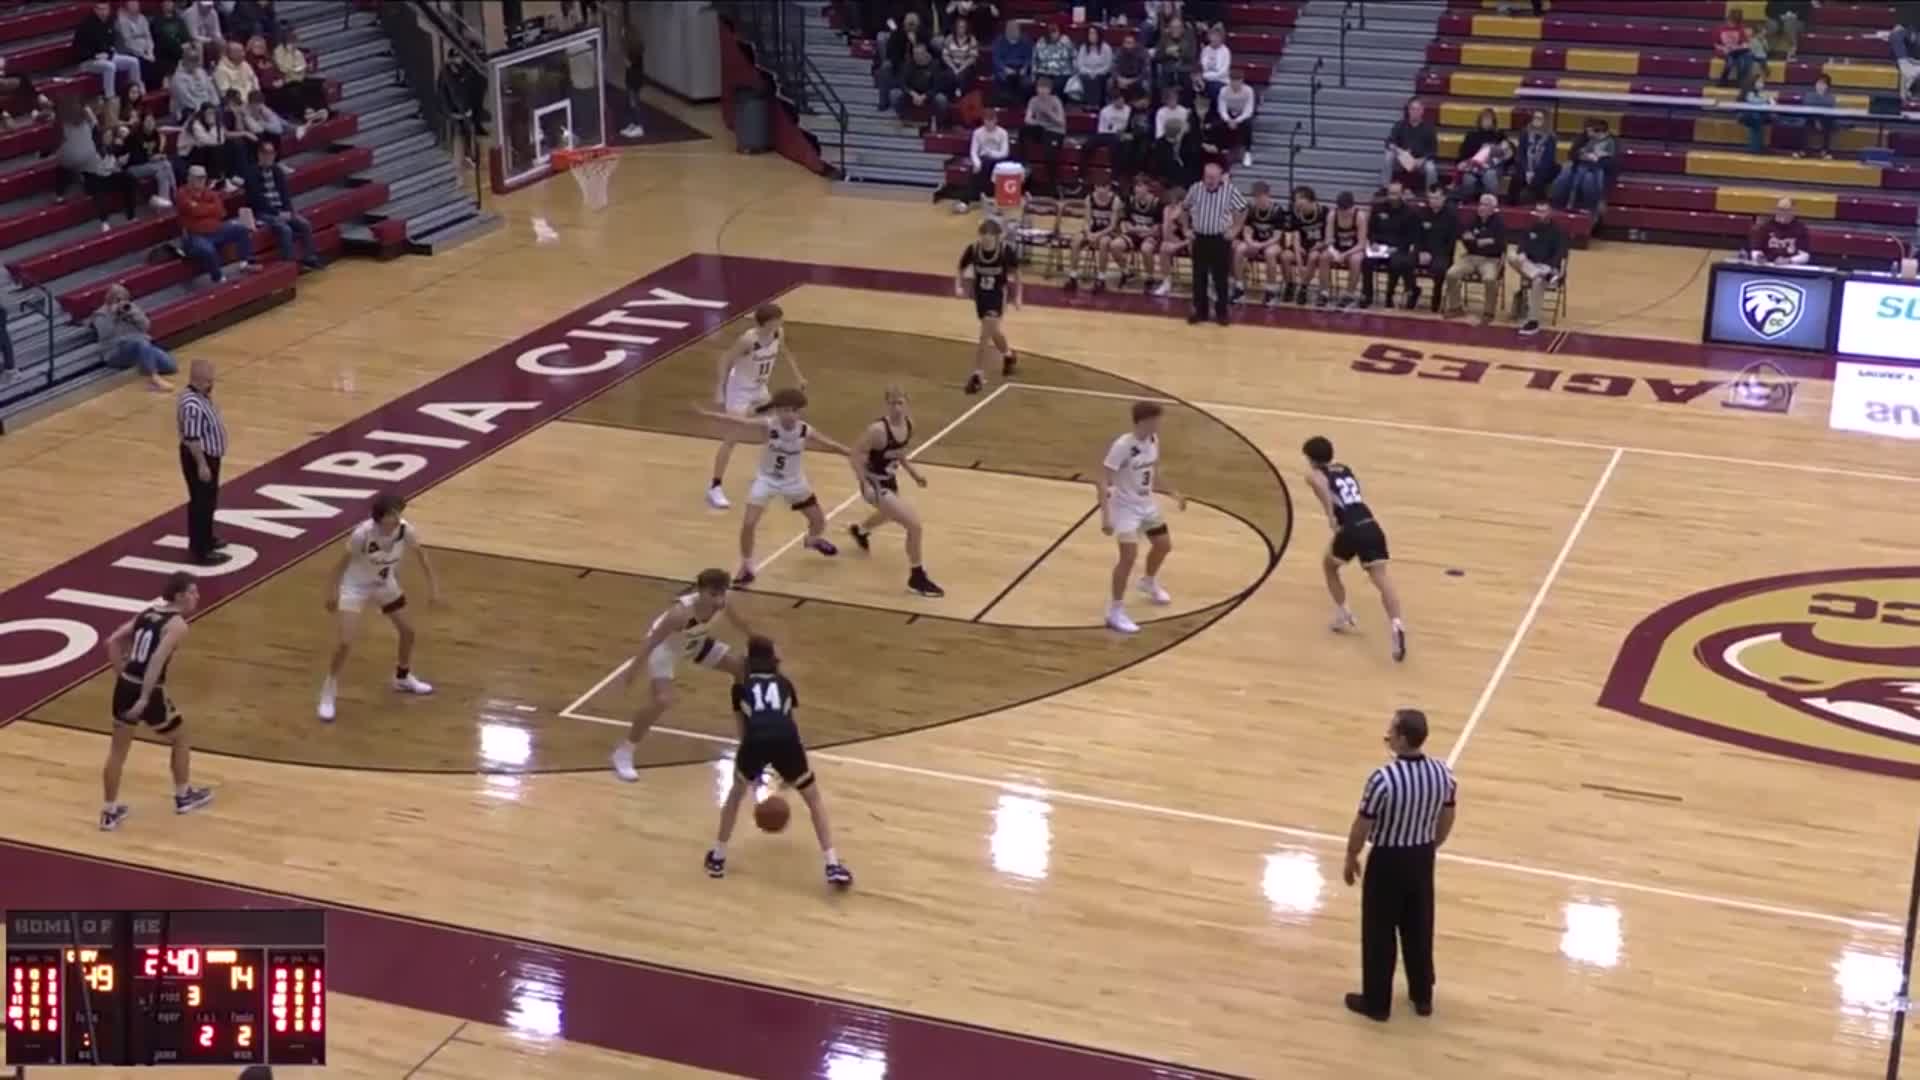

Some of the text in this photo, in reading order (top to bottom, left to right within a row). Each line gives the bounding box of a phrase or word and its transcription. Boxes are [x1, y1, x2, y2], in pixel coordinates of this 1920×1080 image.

[515, 287, 730, 376] CITY
[1351, 343, 1728, 404] AGLES
[774, 455, 785, 471] 5
[1141, 470, 1151, 487] 3
[1335, 476, 1361, 504] 22
[130, 628, 153, 663] 10
[752, 681, 781, 711] 14
